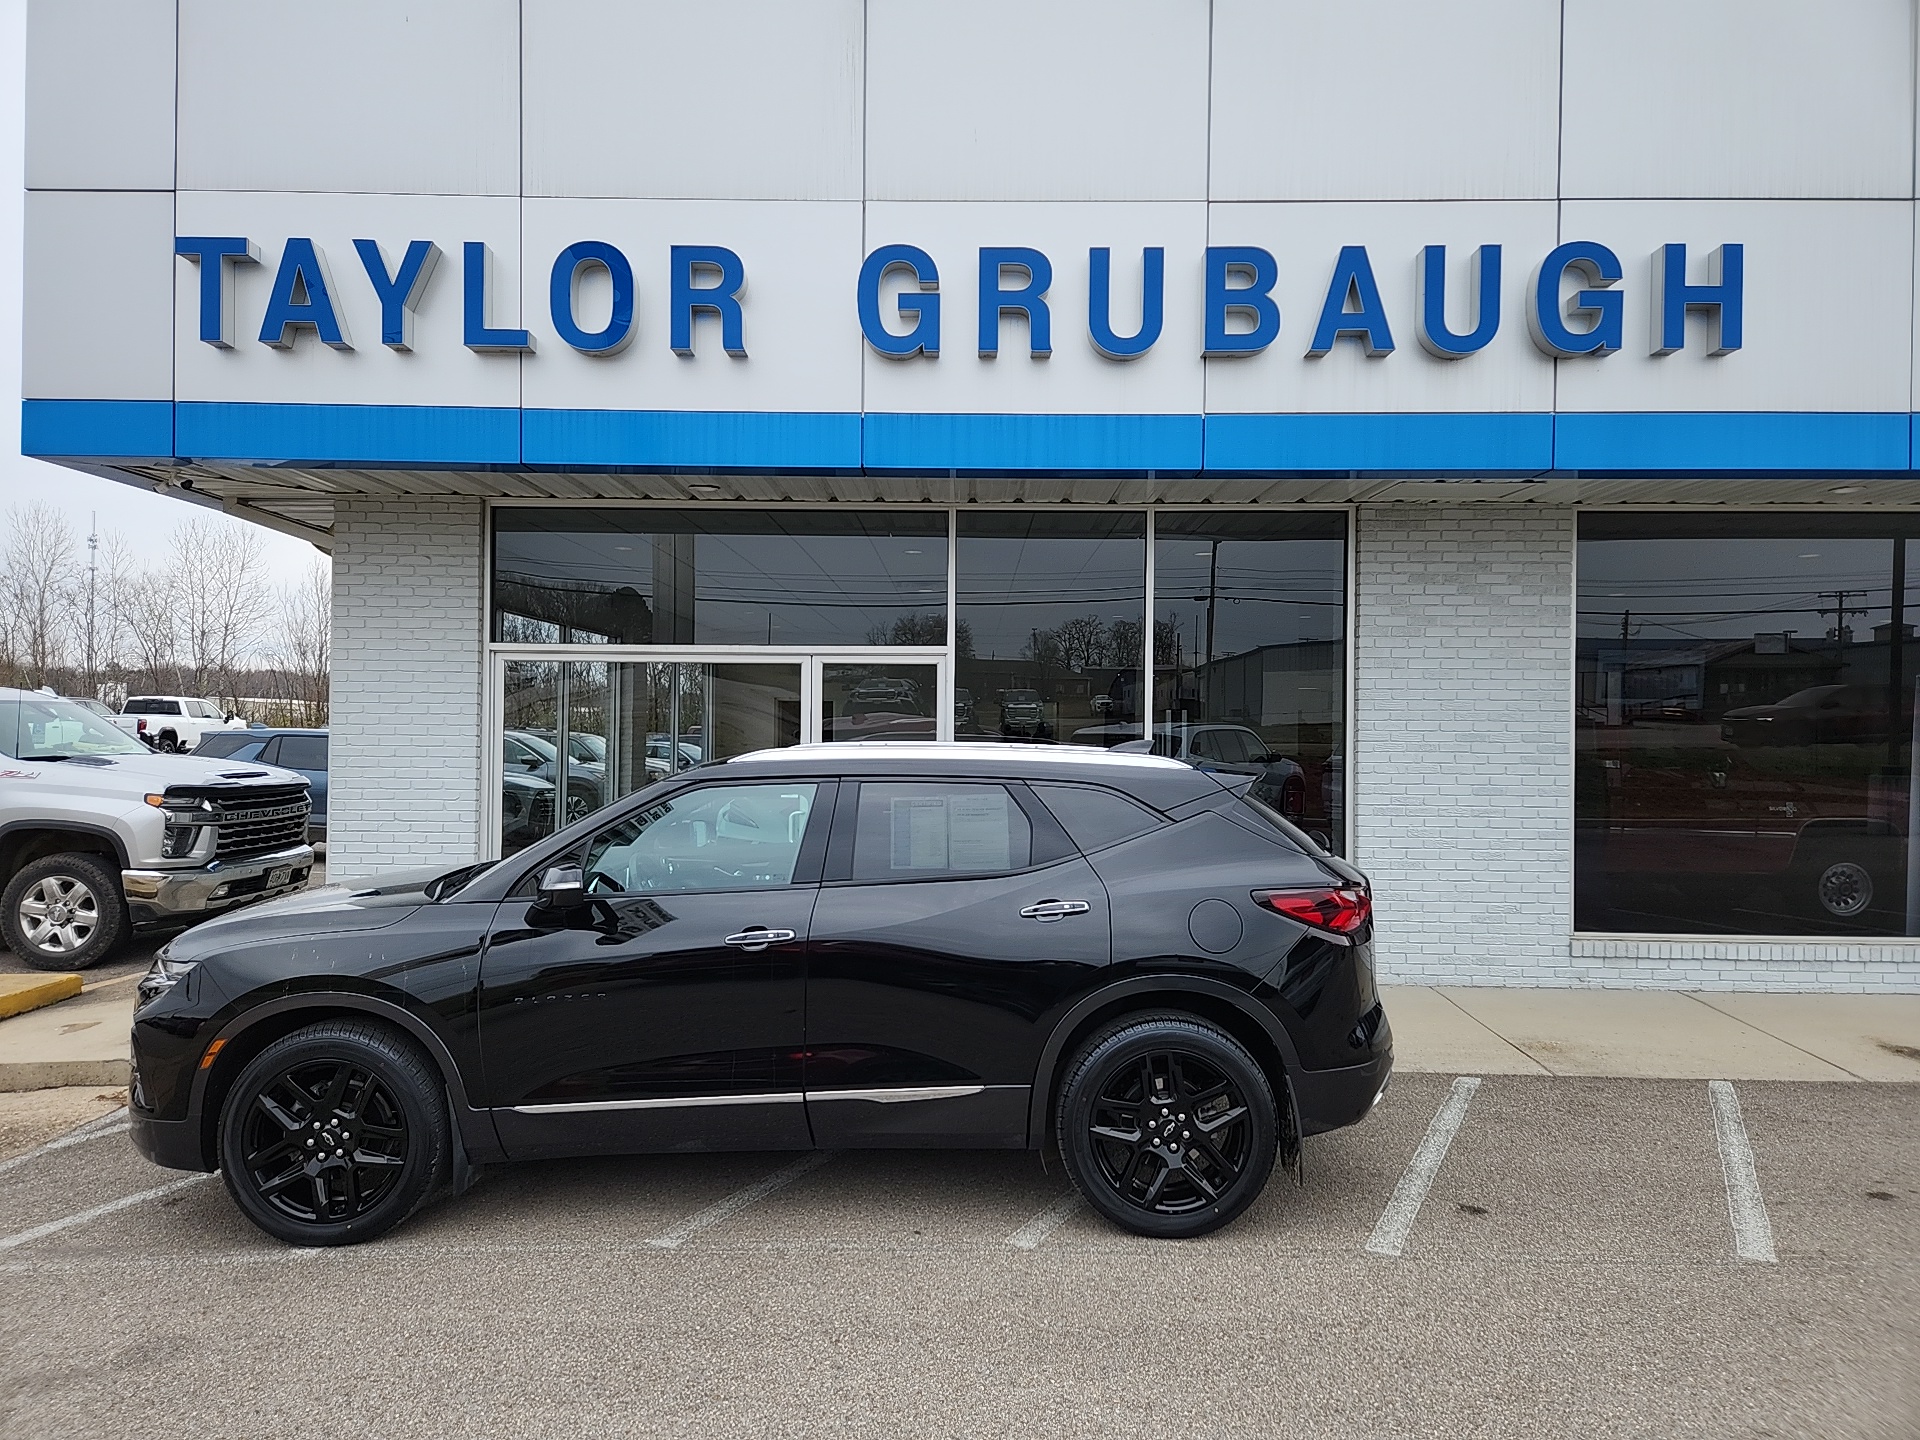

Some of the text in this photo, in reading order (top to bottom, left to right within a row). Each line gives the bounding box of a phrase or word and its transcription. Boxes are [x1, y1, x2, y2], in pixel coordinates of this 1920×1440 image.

[174, 236, 1744, 361] TAYLOR GRUBAUGH
[224, 803, 310, 821] CHEVROLET
